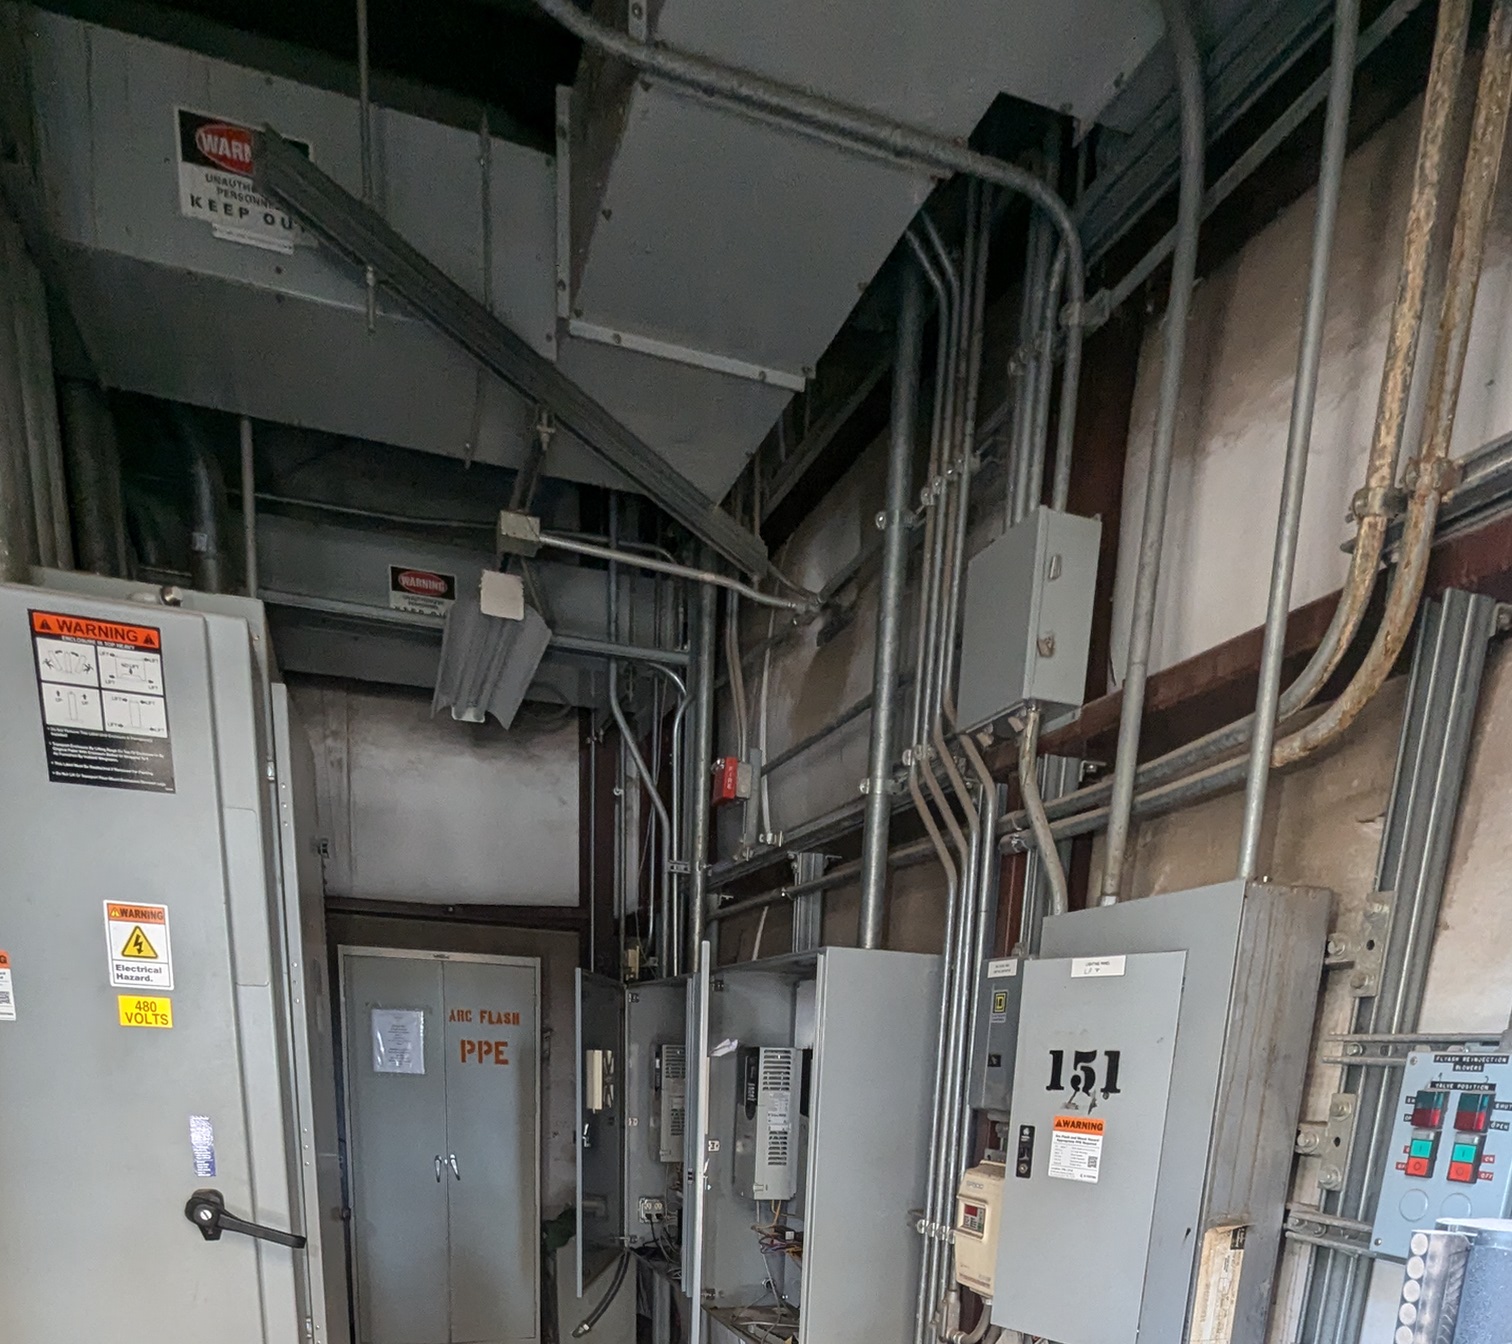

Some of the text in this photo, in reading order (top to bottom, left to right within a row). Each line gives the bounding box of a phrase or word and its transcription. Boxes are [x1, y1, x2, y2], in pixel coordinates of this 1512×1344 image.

[202, 134, 252, 163] WARN
[206, 174, 251, 192] UNAUTH
[190, 194, 250, 219] KEEP
[401, 576, 445, 592] WARNING
[56, 618, 138, 643] WARNING
[120, 908, 164, 920] WARNING
[115, 964, 162, 974] Electrical
[116, 973, 153, 982] Hazard.
[135, 1001, 157, 1012] 480
[125, 1012, 169, 1025] VOLTS
[449, 1009, 520, 1025] ARC FLASH
[460, 1039, 509, 1065] PPE
[1046, 1050, 1121, 1096] 151
[1062, 1119, 1103, 1131] WARNING
